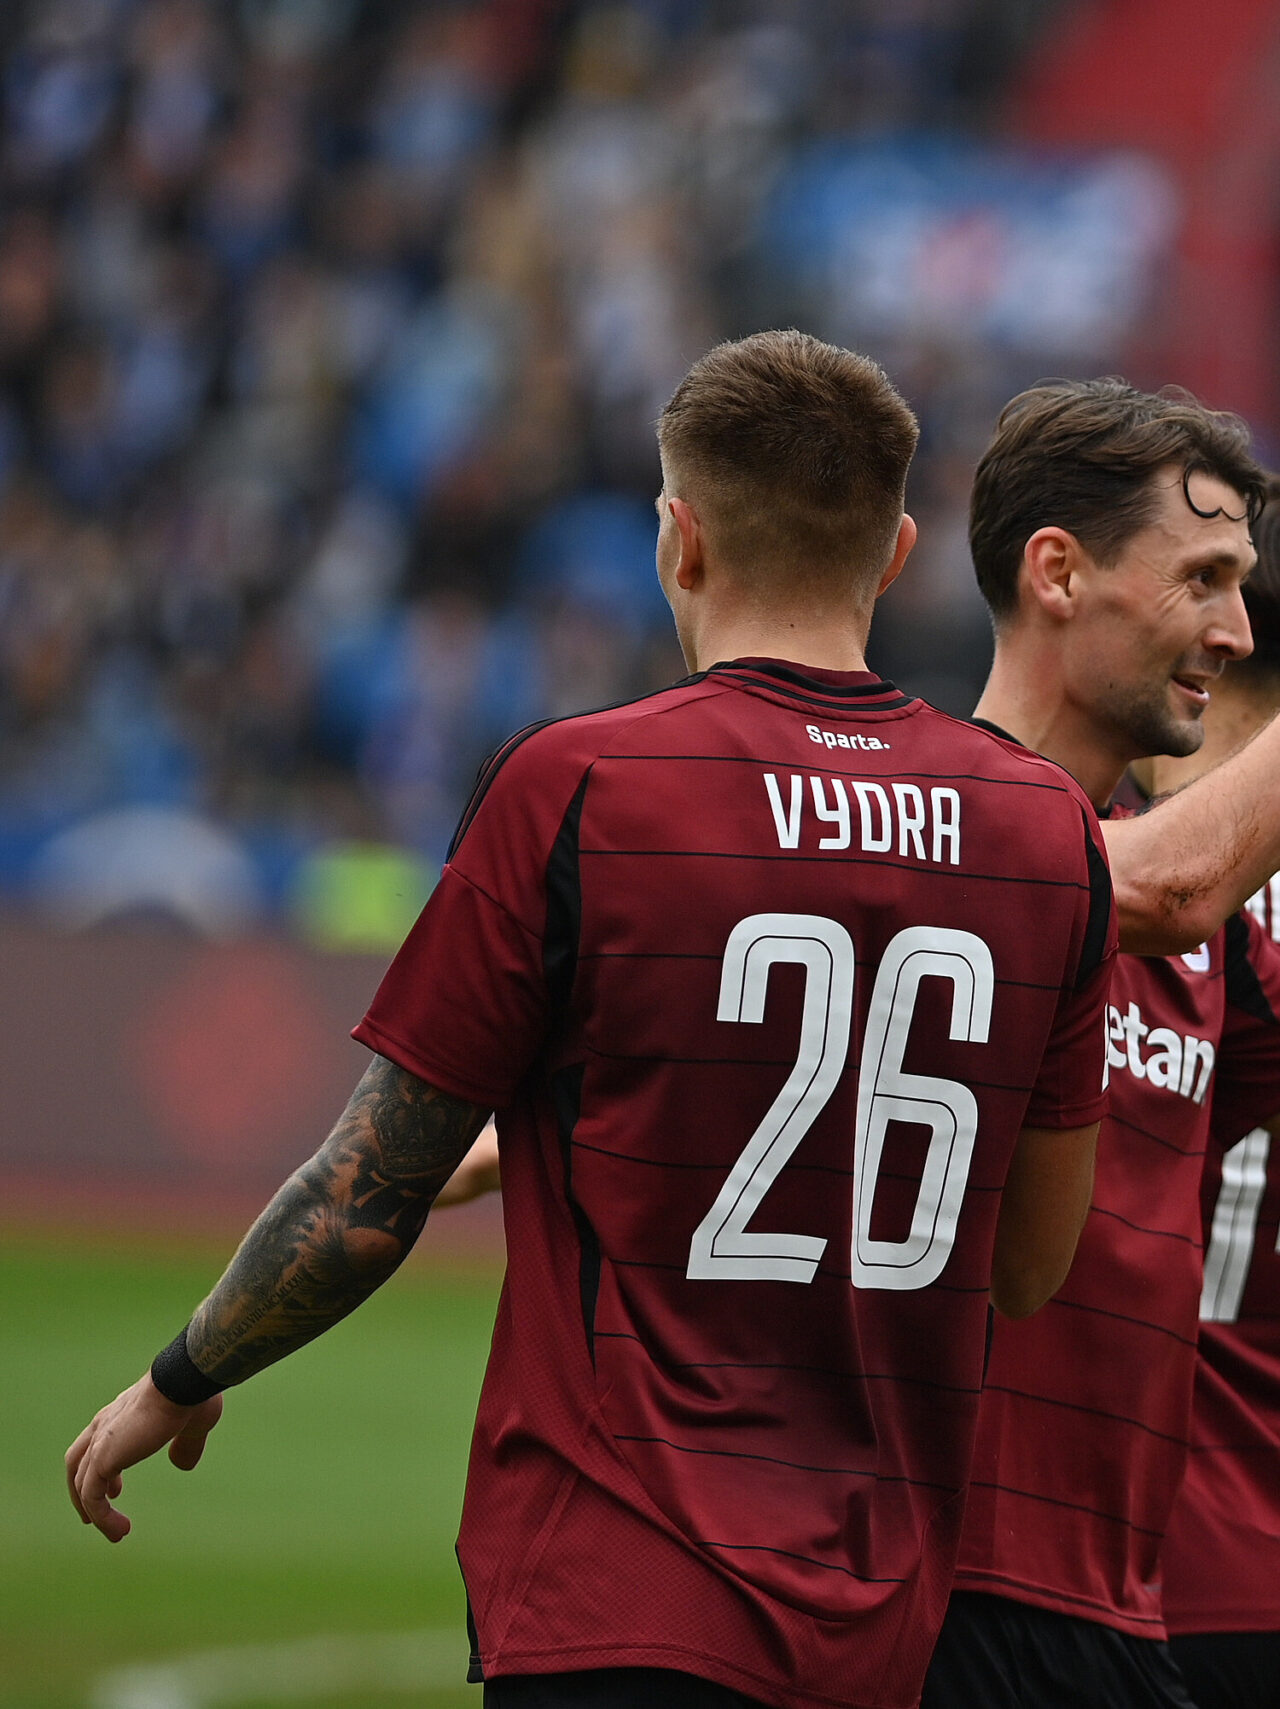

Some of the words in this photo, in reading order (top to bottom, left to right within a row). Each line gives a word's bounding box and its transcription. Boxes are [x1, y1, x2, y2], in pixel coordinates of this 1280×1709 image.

[806, 724, 890, 751] Sparta.
[763, 773, 960, 865] VYDRA
[686, 913, 994, 1291] 26
